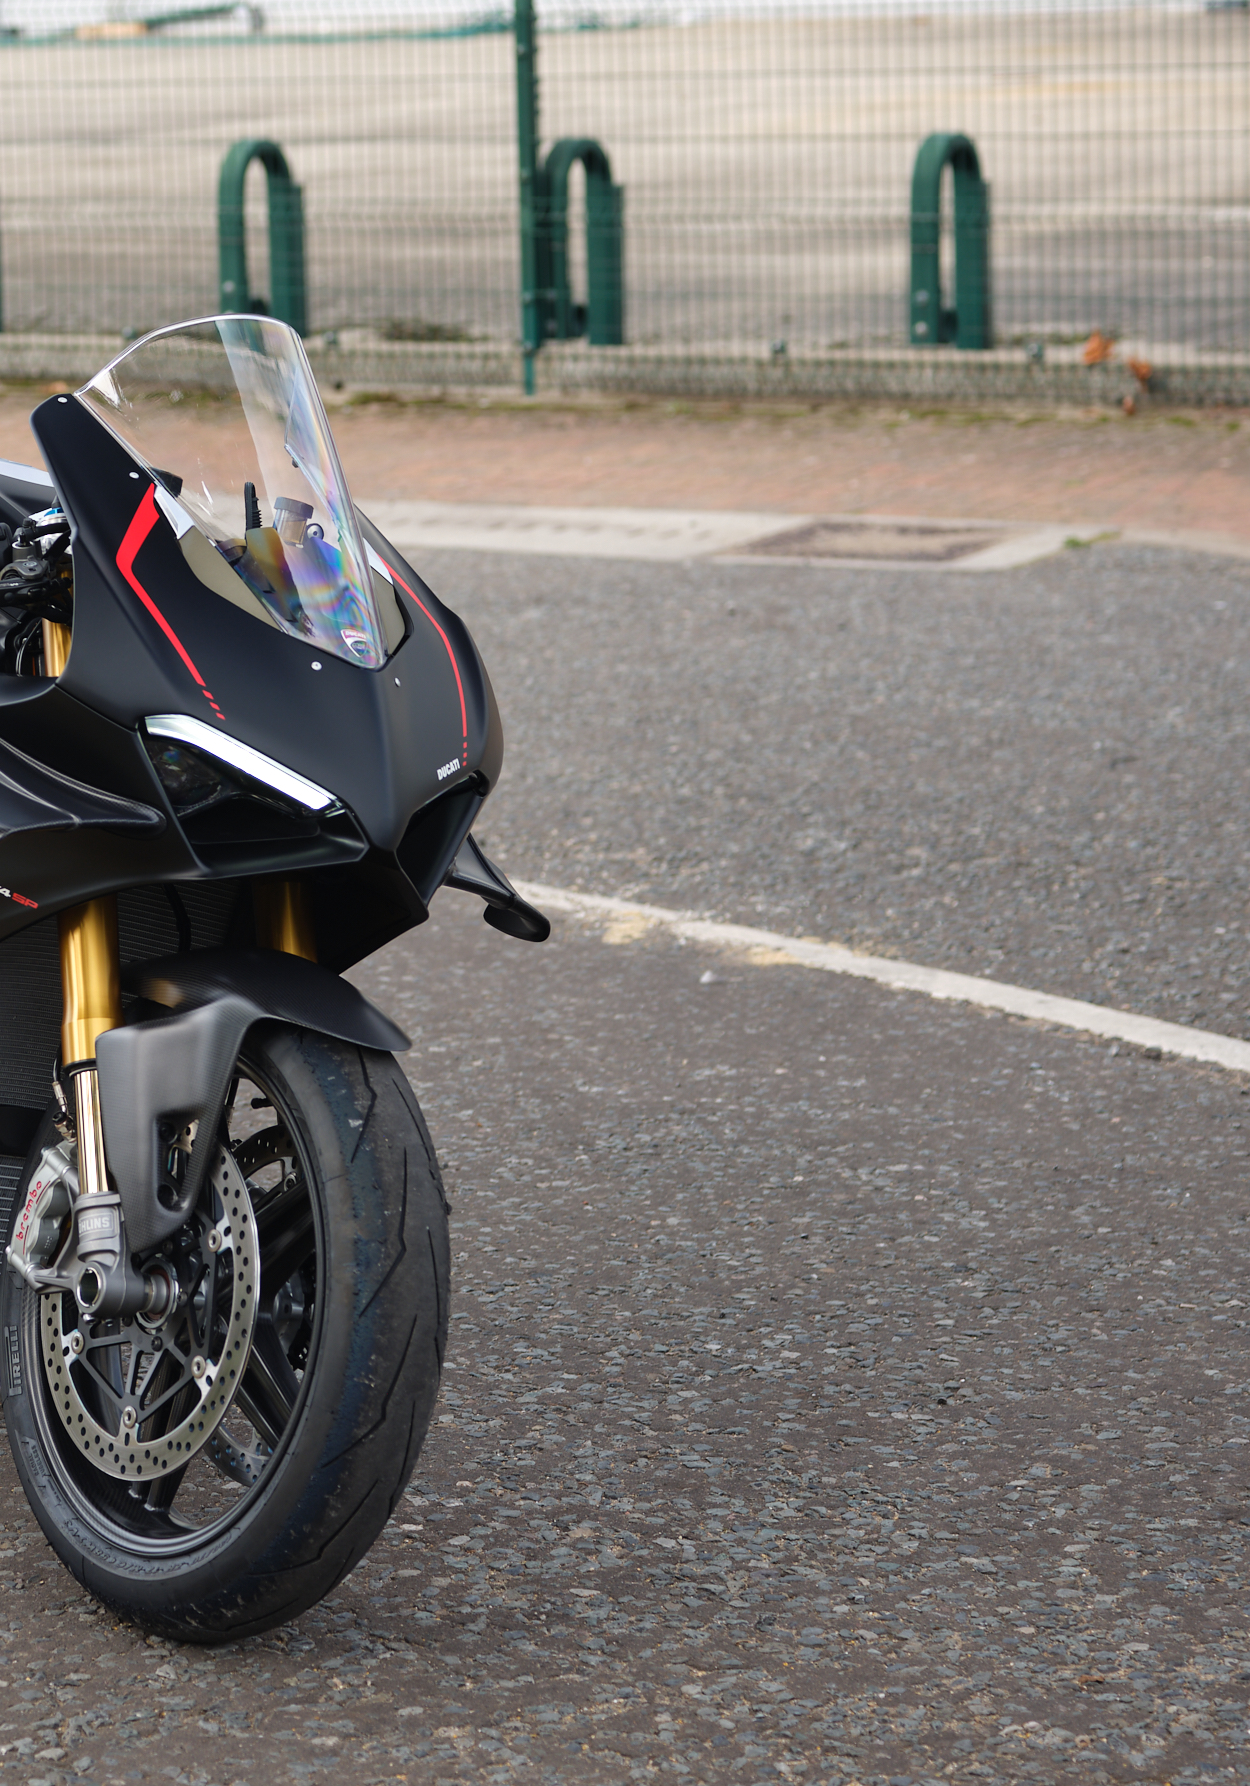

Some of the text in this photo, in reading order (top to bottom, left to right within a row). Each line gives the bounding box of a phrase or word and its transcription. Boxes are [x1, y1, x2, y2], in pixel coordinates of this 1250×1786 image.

[436, 757, 461, 781] DUCATI
[15, 1180, 43, 1241] brembo
[4, 1325, 23, 1397] PIRELLI
